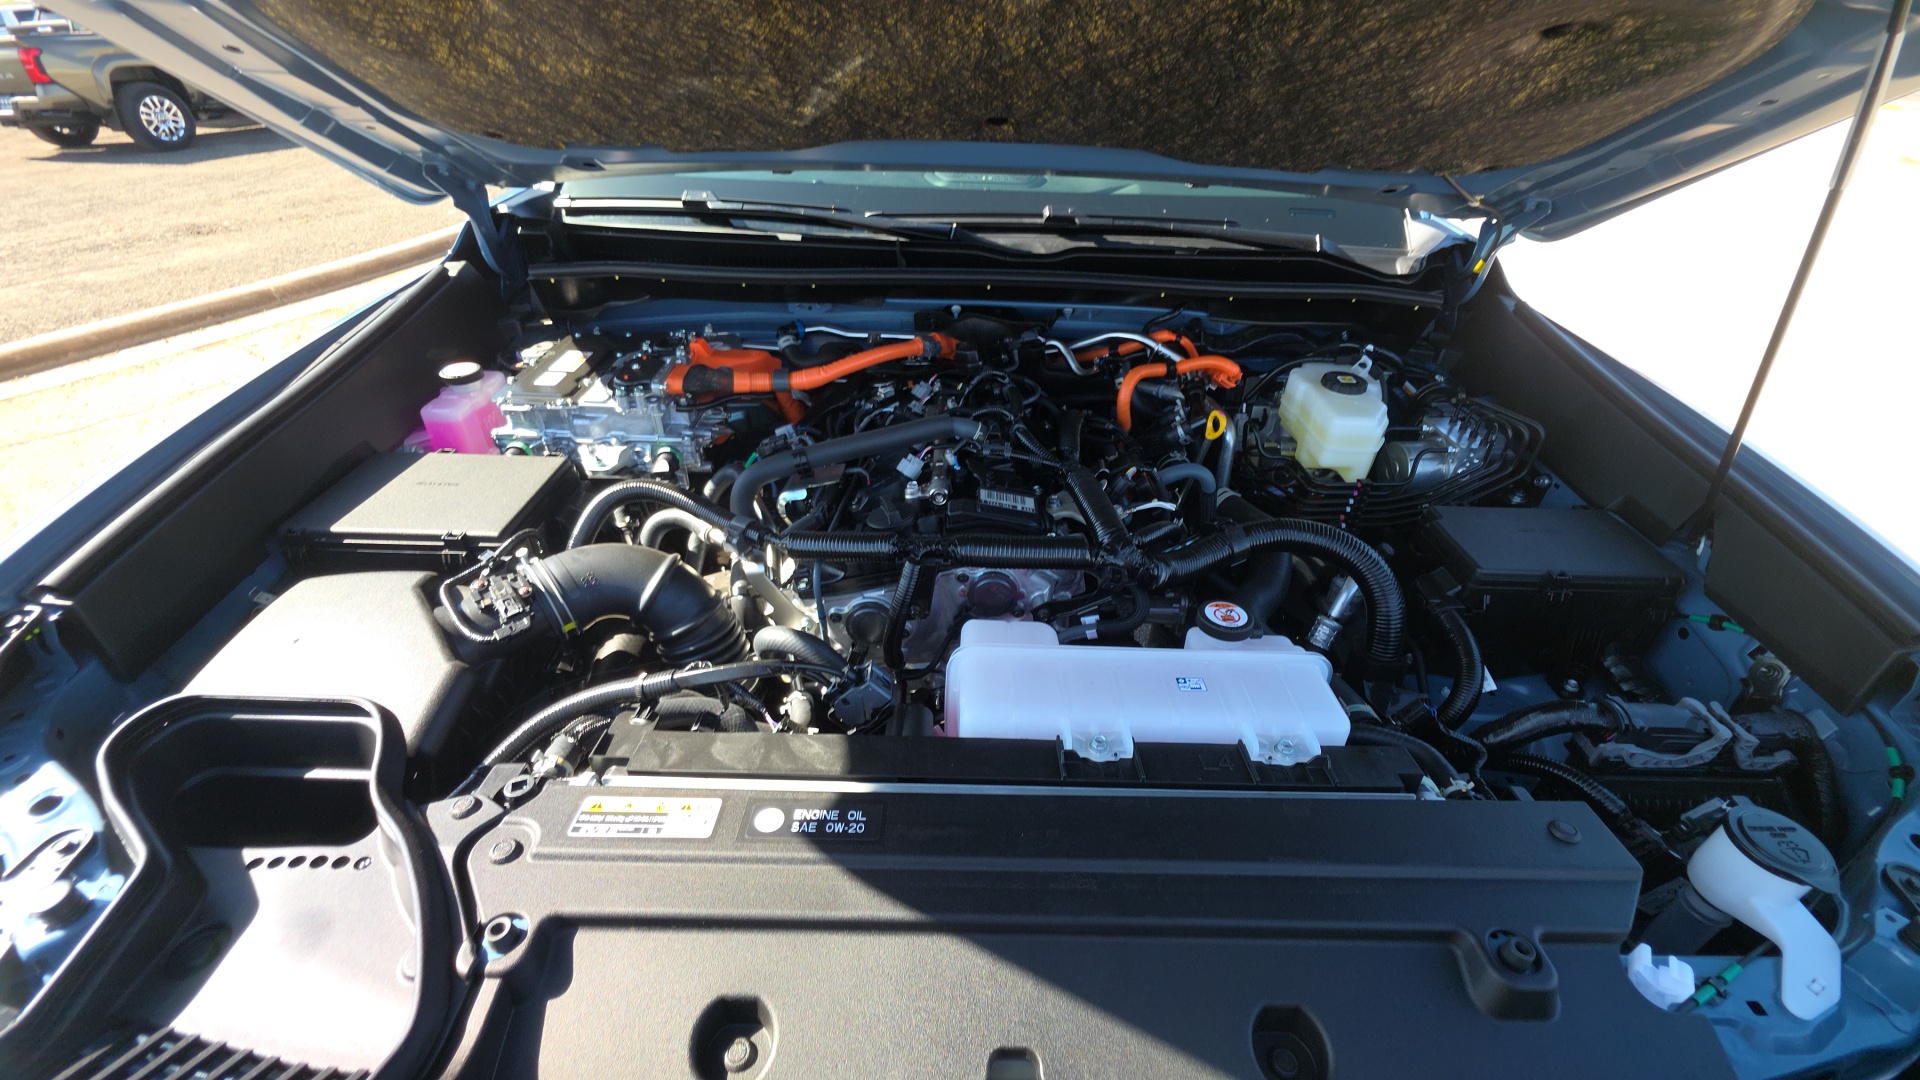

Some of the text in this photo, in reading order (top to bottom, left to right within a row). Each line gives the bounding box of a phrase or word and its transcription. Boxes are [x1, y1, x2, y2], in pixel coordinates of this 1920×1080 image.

[793, 808, 867, 821] ENGINE OIL
[791, 821, 865, 833] SAE 0W-20
